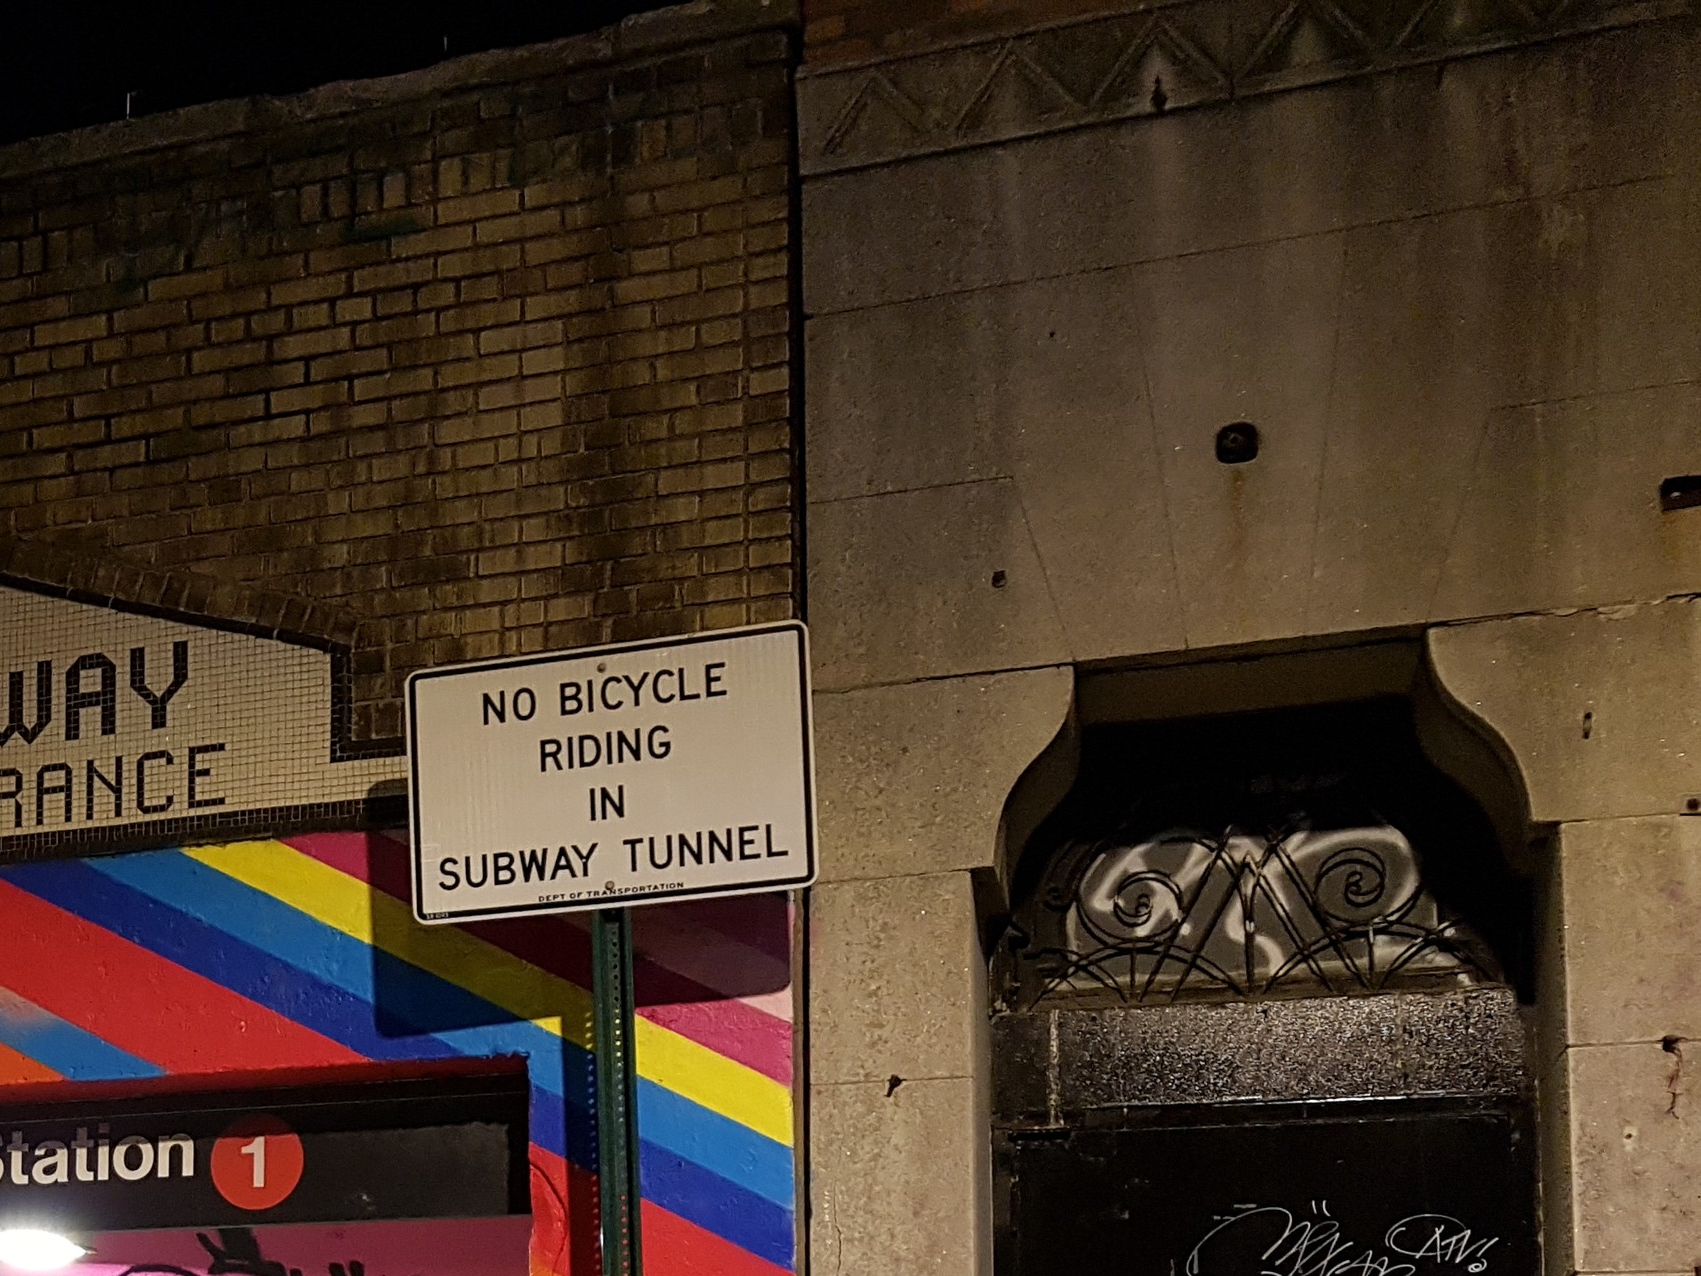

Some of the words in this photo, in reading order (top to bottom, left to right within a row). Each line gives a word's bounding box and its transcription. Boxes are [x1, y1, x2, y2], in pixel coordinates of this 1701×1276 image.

[482, 687, 537, 725] NO
[559, 662, 728, 716] BICYCLE
[540, 725, 671, 772] RIDING
[589, 784, 625, 821] IN
[439, 843, 598, 891] SUBWAY
[623, 823, 789, 872] TUNNEL
[539, 893, 565, 902] DEPT
[569, 891, 583, 899] OF
[587, 882, 684, 897] TRANSPORTATION
[240, 1137, 266, 1188] 1
